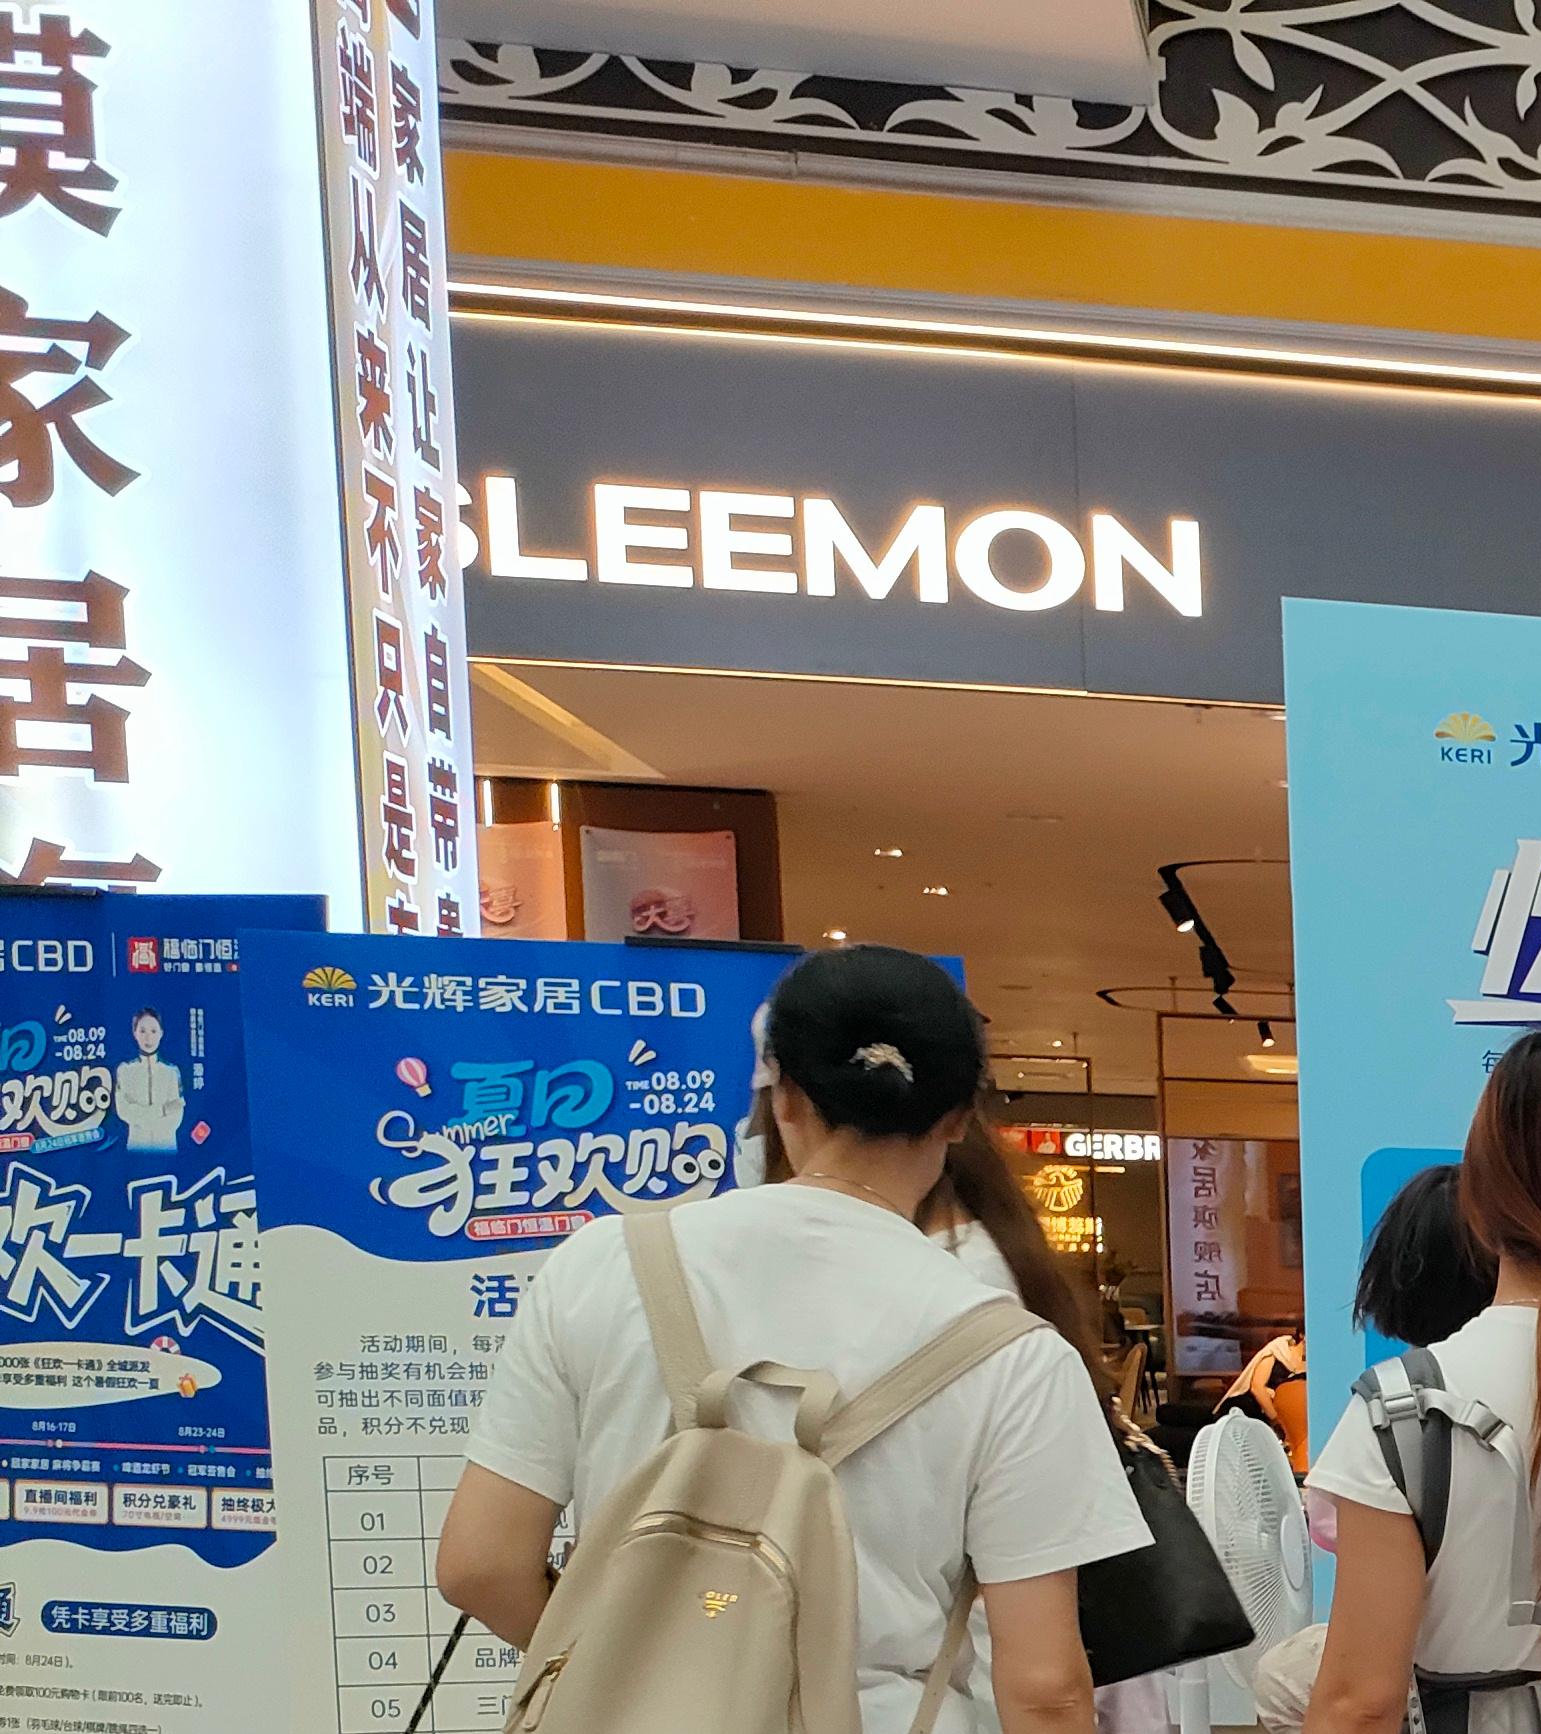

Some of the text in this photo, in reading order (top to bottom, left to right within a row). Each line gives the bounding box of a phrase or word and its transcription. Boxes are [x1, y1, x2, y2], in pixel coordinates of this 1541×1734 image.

[337, 0, 418, 933] 端从来不只是
[387, 0, 462, 931] 家居让家自带
[457, 475, 1203, 617] LEEMON
[1440, 747, 1492, 764] KERI
[0, 940, 94, 972] CBD
[163, 938, 239, 961] 福临门恒
[308, 992, 354, 1008] KERI
[367, 973, 706, 1018] 光辉家居CBD
[68, 1027, 106, 1042] 08.09
[55, 1045, 106, 1061] -08.24
[626, 1072, 715, 1091] TIME 08.09
[629, 1092, 716, 1115] -08.24
[377, 1110, 516, 1157] Smmer
[470, 1273, 535, 1318] 活
[0, 1373, 67, 1386] 享受多重福利
[313, 1361, 494, 1381] 参与抽奖有机会抽
[347, 1464, 394, 1486] 序号
[24, 1488, 97, 1506] 直播间福利
[123, 1493, 196, 1511] 积分兑豪礼
[360, 1513, 385, 1532] 01
[363, 1556, 393, 1574] 02
[51, 1605, 208, 1636] 凭卡享受多重福利
[366, 1604, 396, 1622] 03
[368, 1652, 398, 1670] 04
[475, 1648, 528, 1668] 品牌
[371, 1699, 401, 1718] 05
